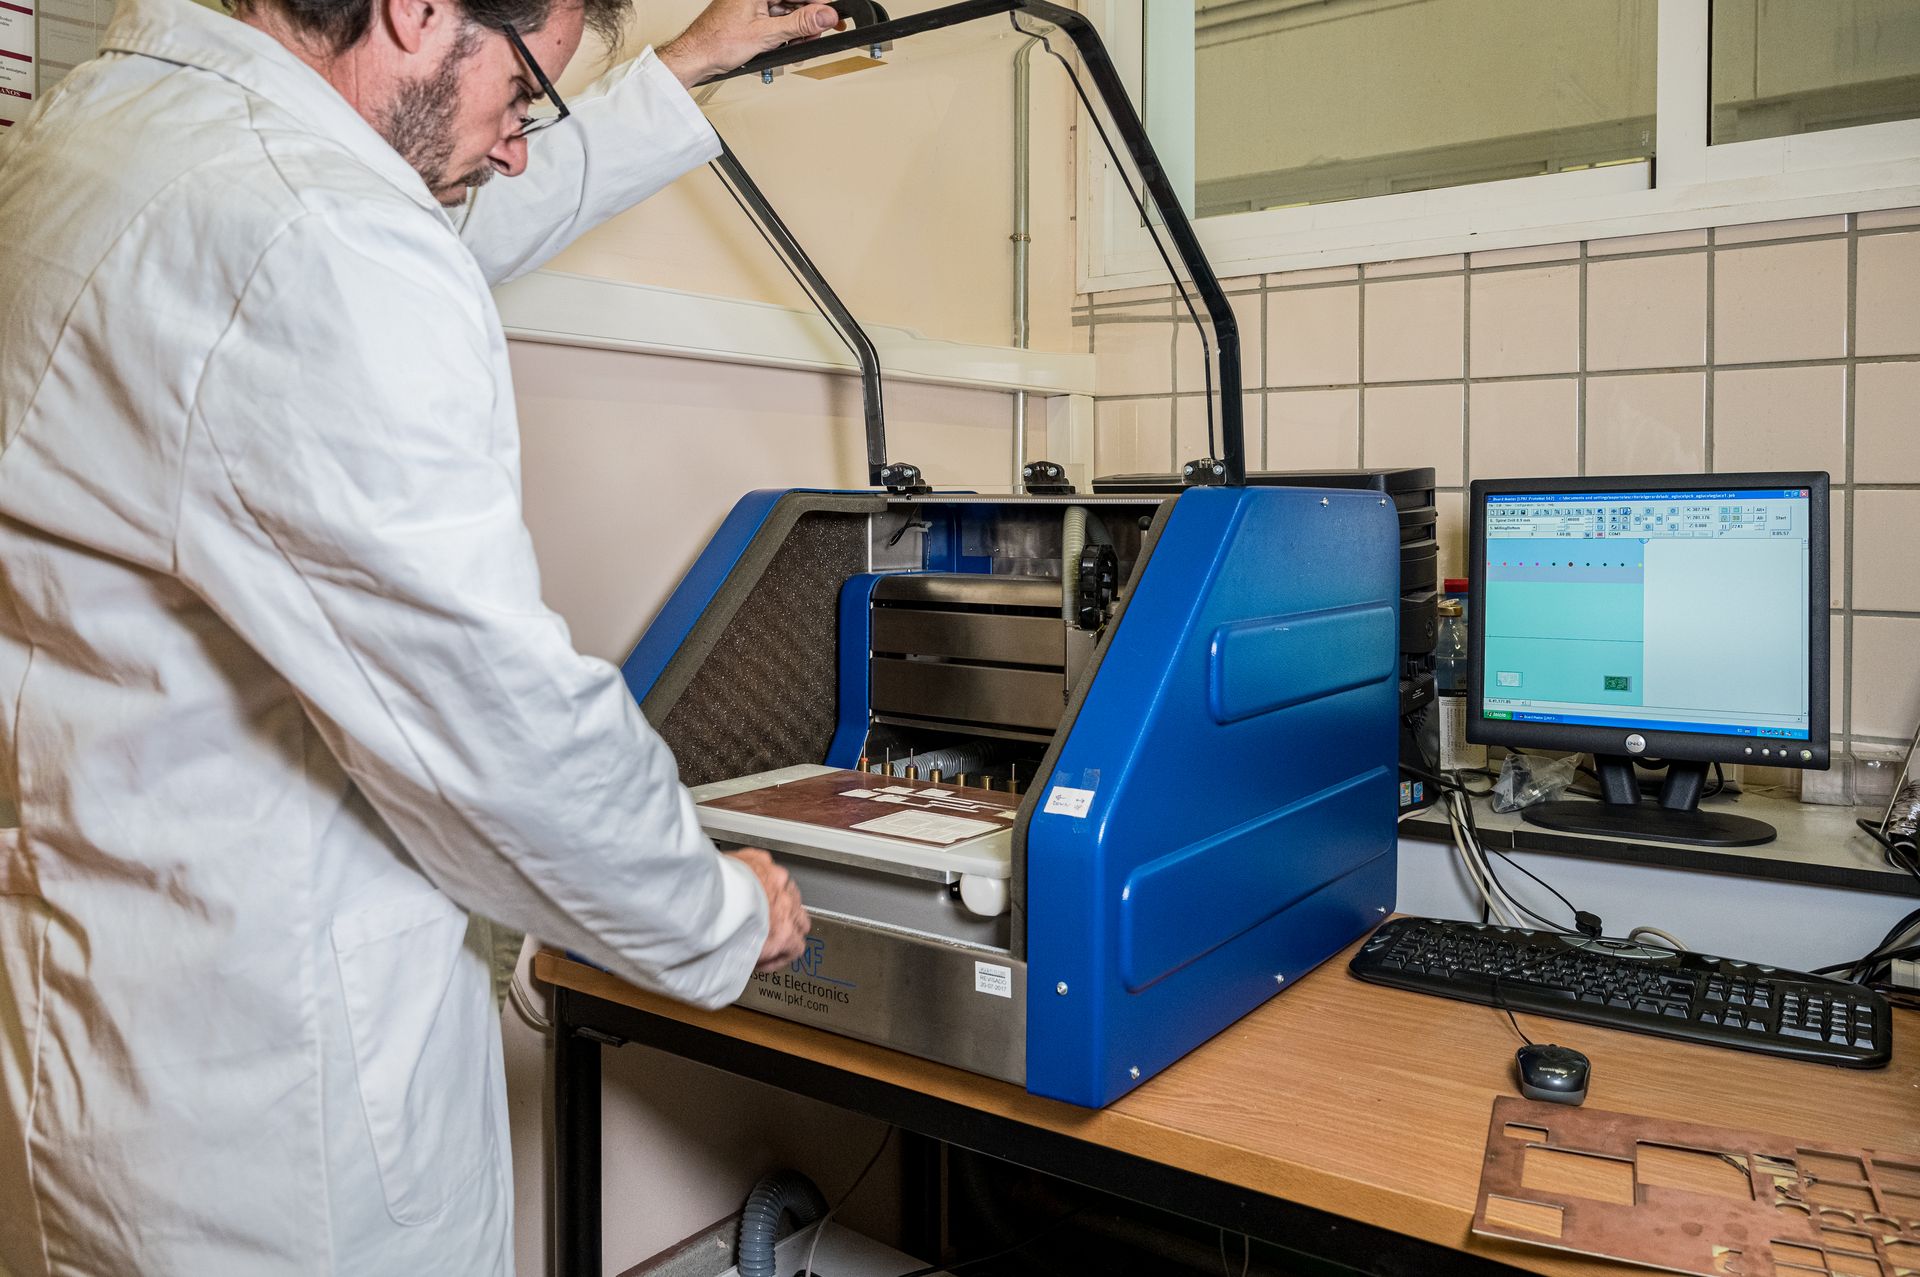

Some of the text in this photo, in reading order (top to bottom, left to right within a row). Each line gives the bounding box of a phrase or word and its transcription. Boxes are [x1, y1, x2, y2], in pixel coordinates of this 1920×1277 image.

[772, 970, 782, 987] &
[784, 974, 850, 1004] Electronics
[980, 974, 1008, 986] REVISADO
[758, 986, 829, 1014] www.lpkf.com
